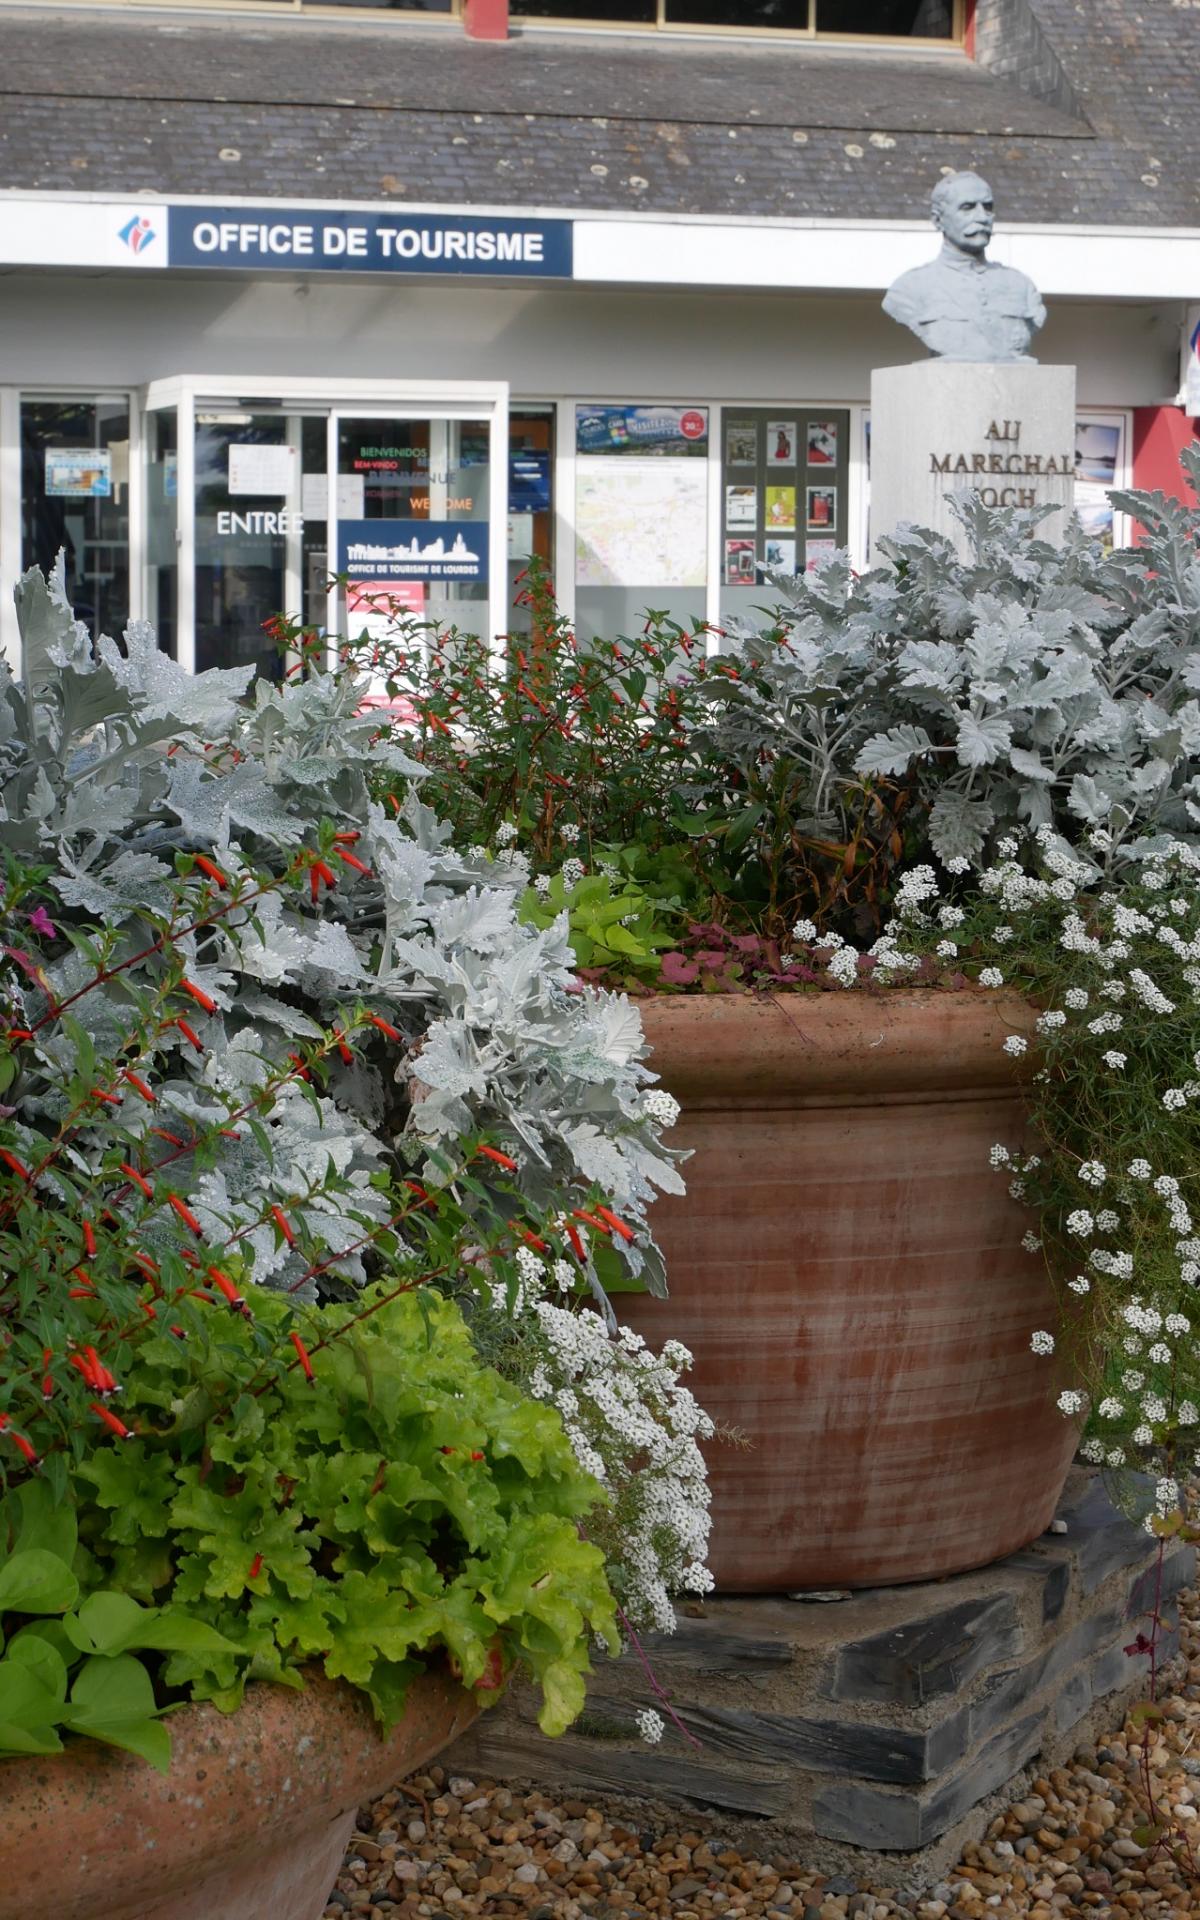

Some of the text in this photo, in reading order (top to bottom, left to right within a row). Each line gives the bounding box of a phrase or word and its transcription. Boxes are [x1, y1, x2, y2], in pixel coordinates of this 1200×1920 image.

[193, 222, 544, 262] OFFICE DE TOURISME
[984, 420, 1022, 441] AU
[360, 447, 427, 458] BIENVENIDOS
[354, 460, 398, 470] BEM-VINDO
[929, 452, 1074, 475] MARECHAL
[974, 487, 1037, 509] OCH
[216, 506, 305, 535] ENTRÉE
[347, 564, 479, 575] OFFICE DE TOURISME DE LOURDES
